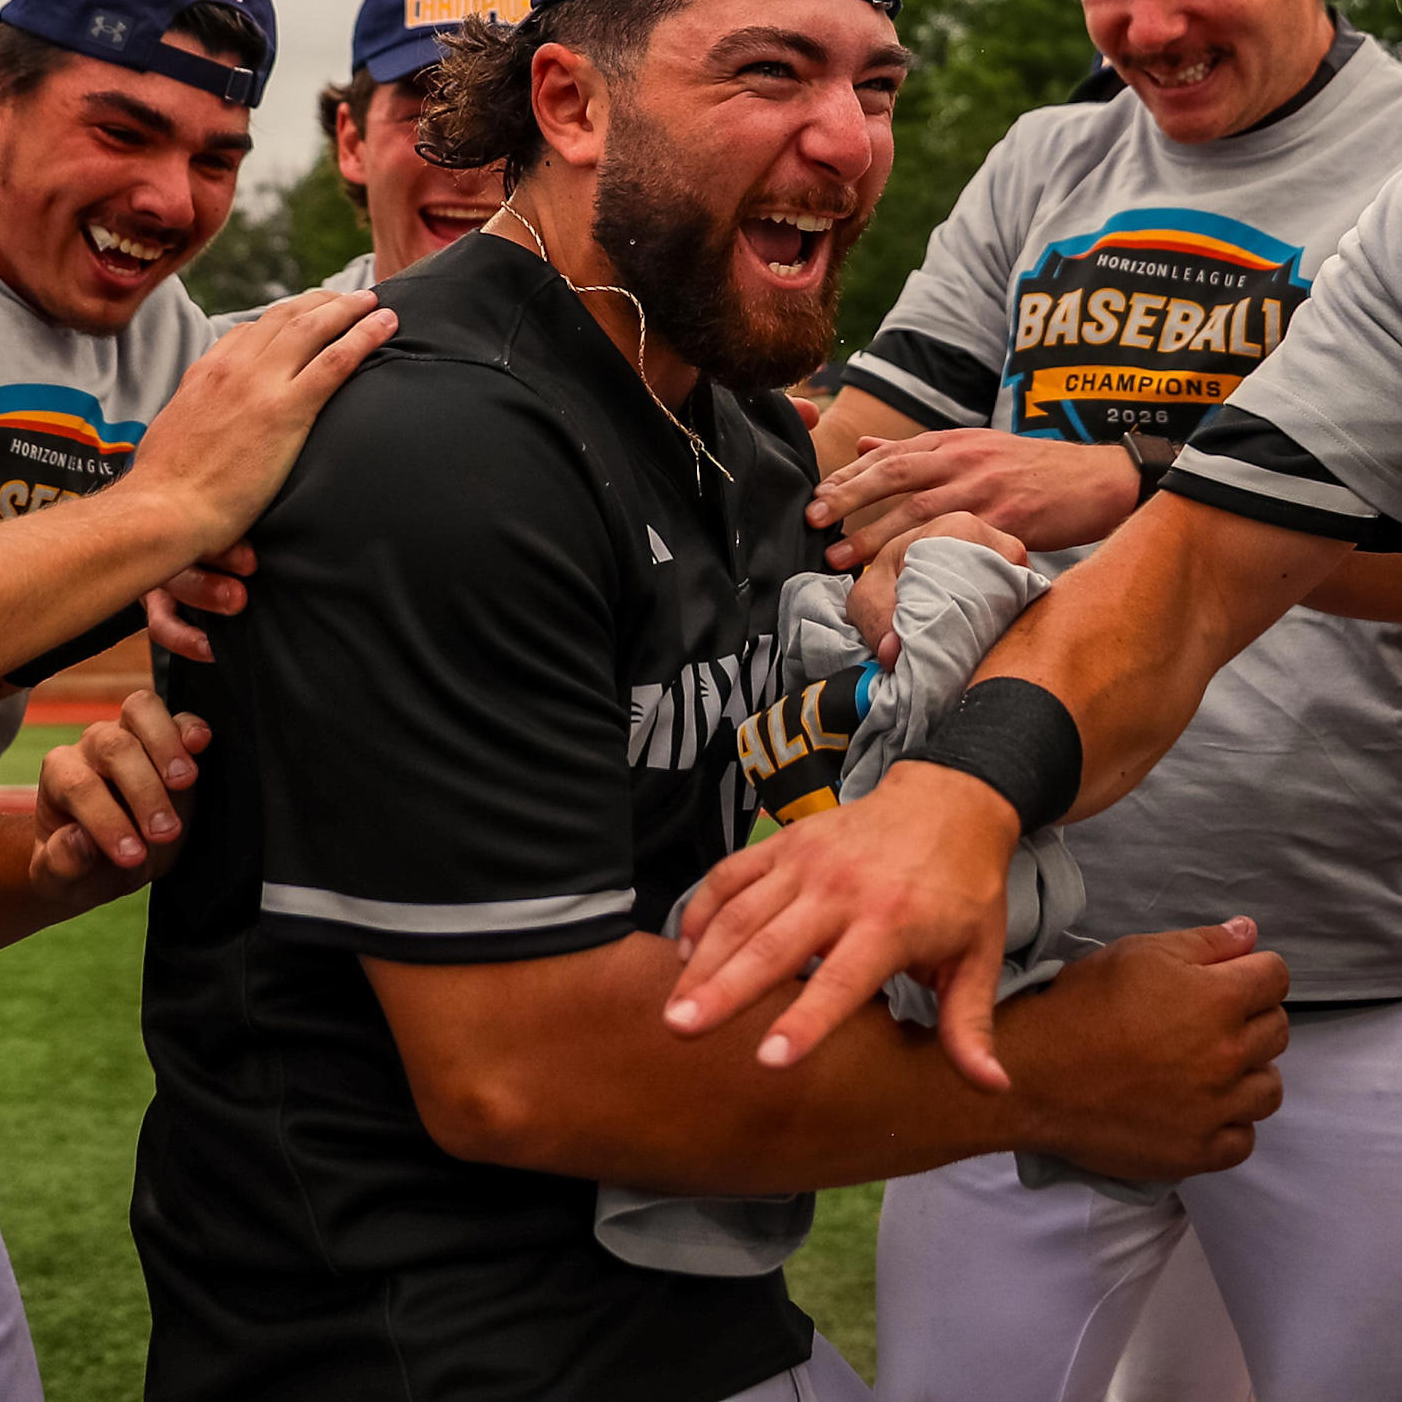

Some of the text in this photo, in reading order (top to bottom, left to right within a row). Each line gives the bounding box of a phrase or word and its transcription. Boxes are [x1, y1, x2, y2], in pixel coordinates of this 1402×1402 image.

[1096, 253, 1247, 288] HORIZON LEAGUE
[1064, 373, 1222, 398] CHAMPIONS
[1107, 408, 1169, 424] 2026
[10, 438, 67, 468] HORIZON
